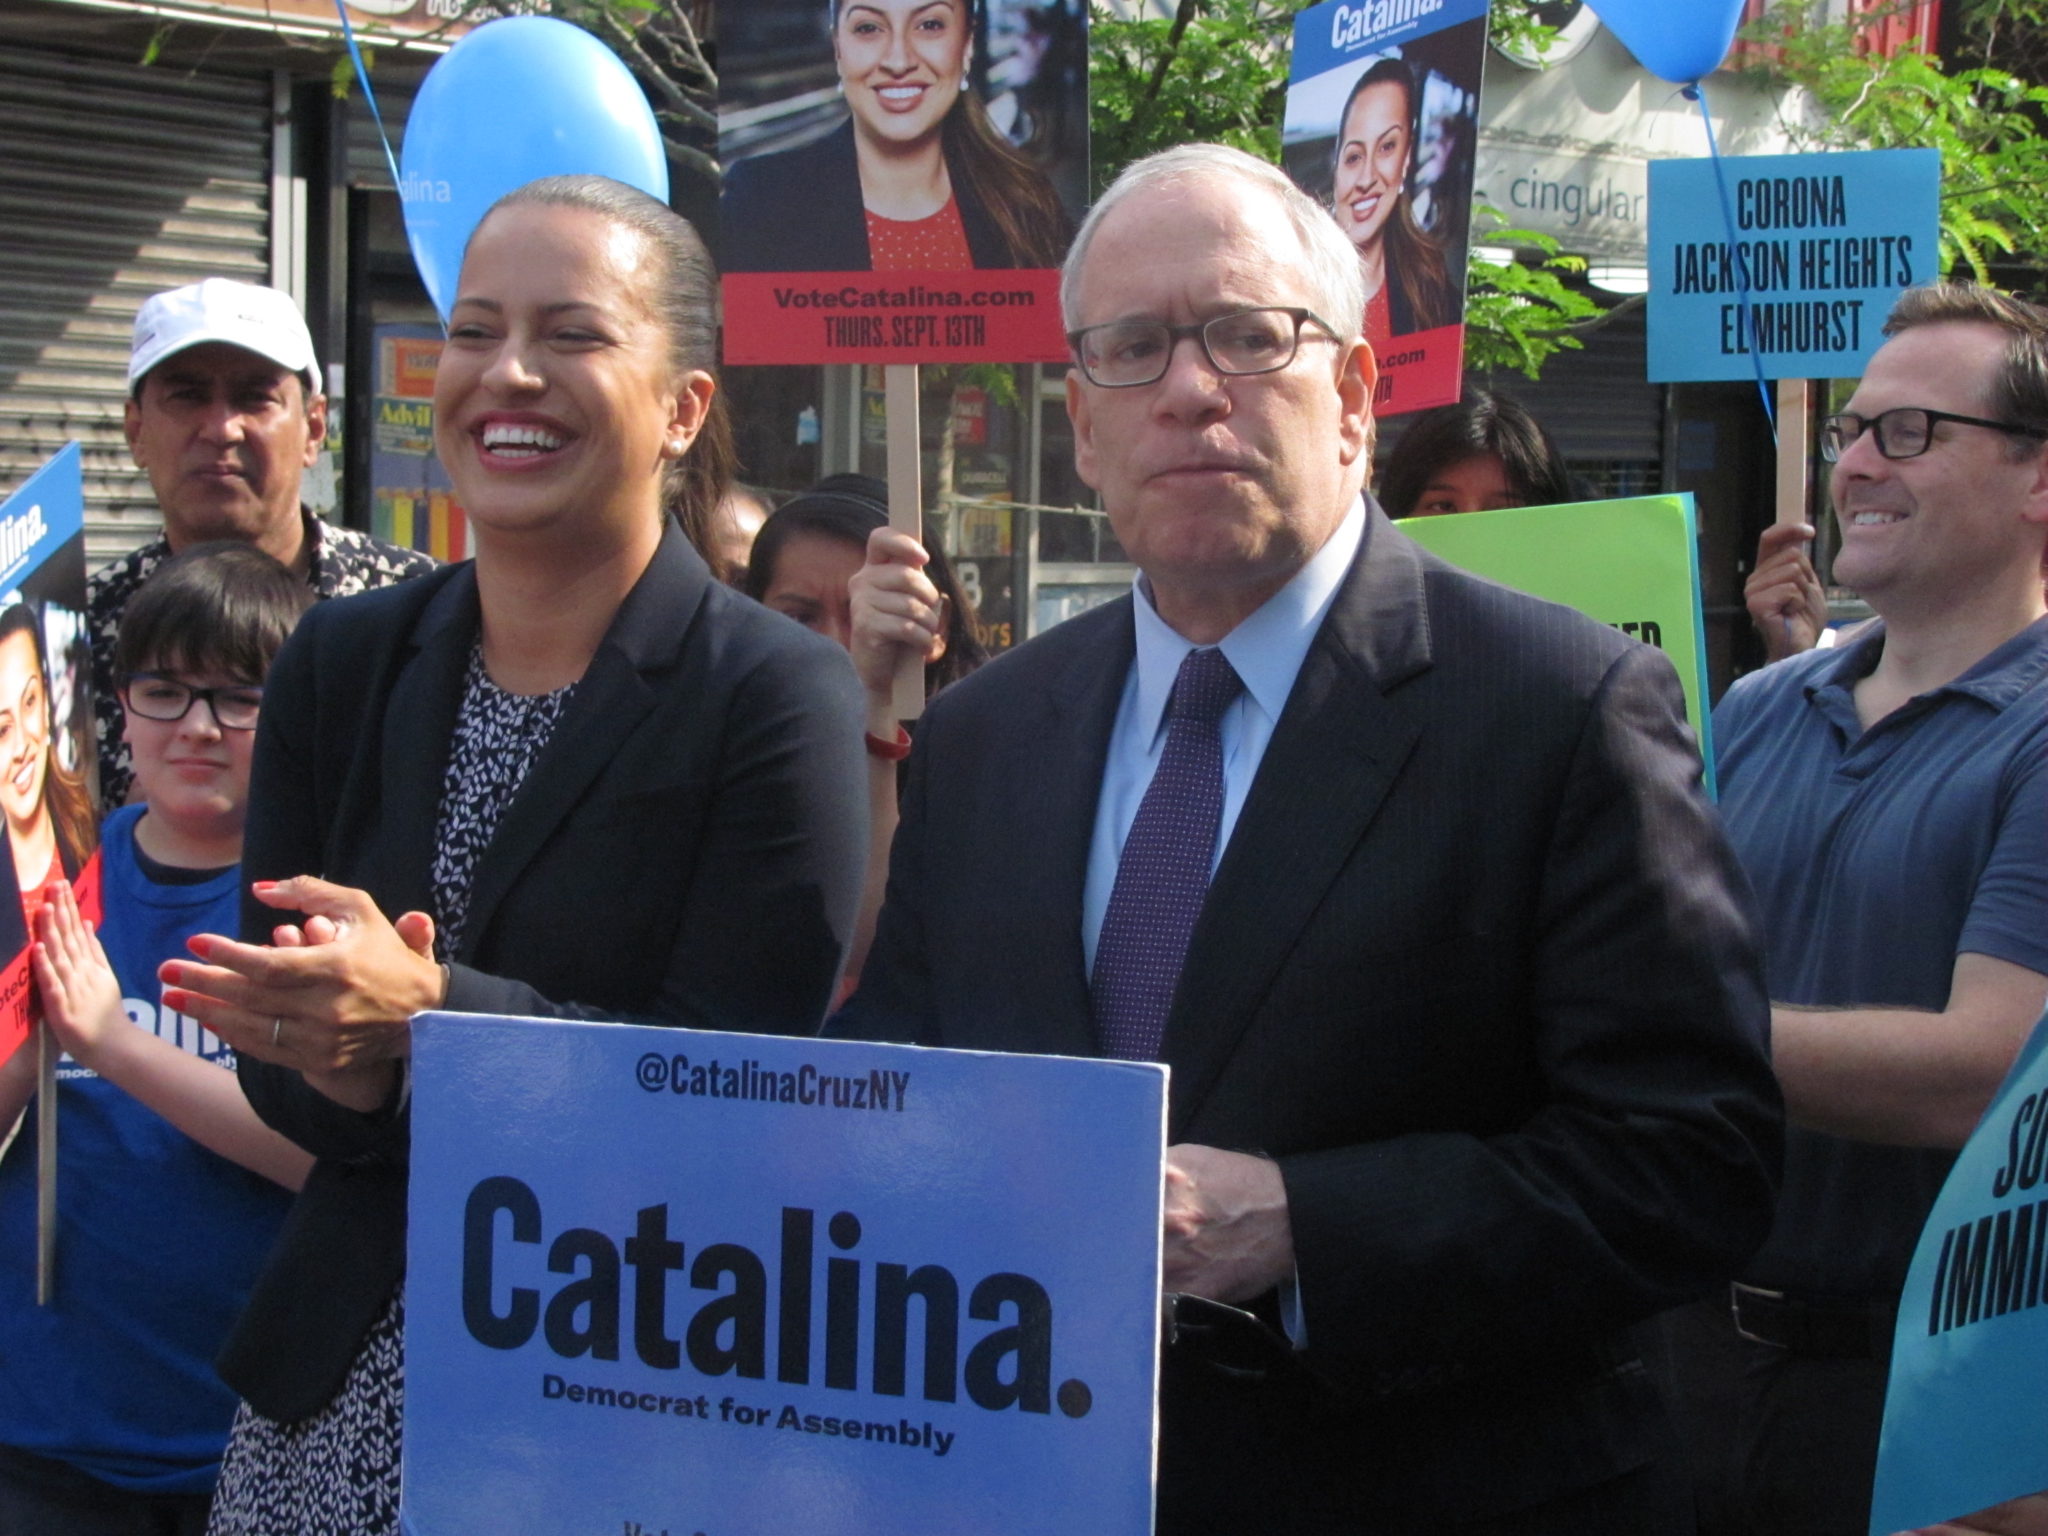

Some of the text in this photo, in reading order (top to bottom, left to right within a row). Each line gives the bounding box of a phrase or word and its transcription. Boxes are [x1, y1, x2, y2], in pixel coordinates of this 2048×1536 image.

[1510, 168, 1644, 227] cingular
[1737, 175, 1847, 231] CORONA
[1672, 235, 1913, 295] JACKSON HEIGHTS
[773, 286, 1036, 309] VoteCatalina.com
[824, 315, 986, 348] THURS. SEPT. 13TH
[1720, 300, 1864, 355] ELMHURST
[635, 1052, 911, 1113] @CatalinaCruzNY
[461, 1174, 1093, 1420] Catalina.
[1928, 1199, 2048, 1338] IMMI
[542, 1373, 956, 1457] Democrat for Assembly
